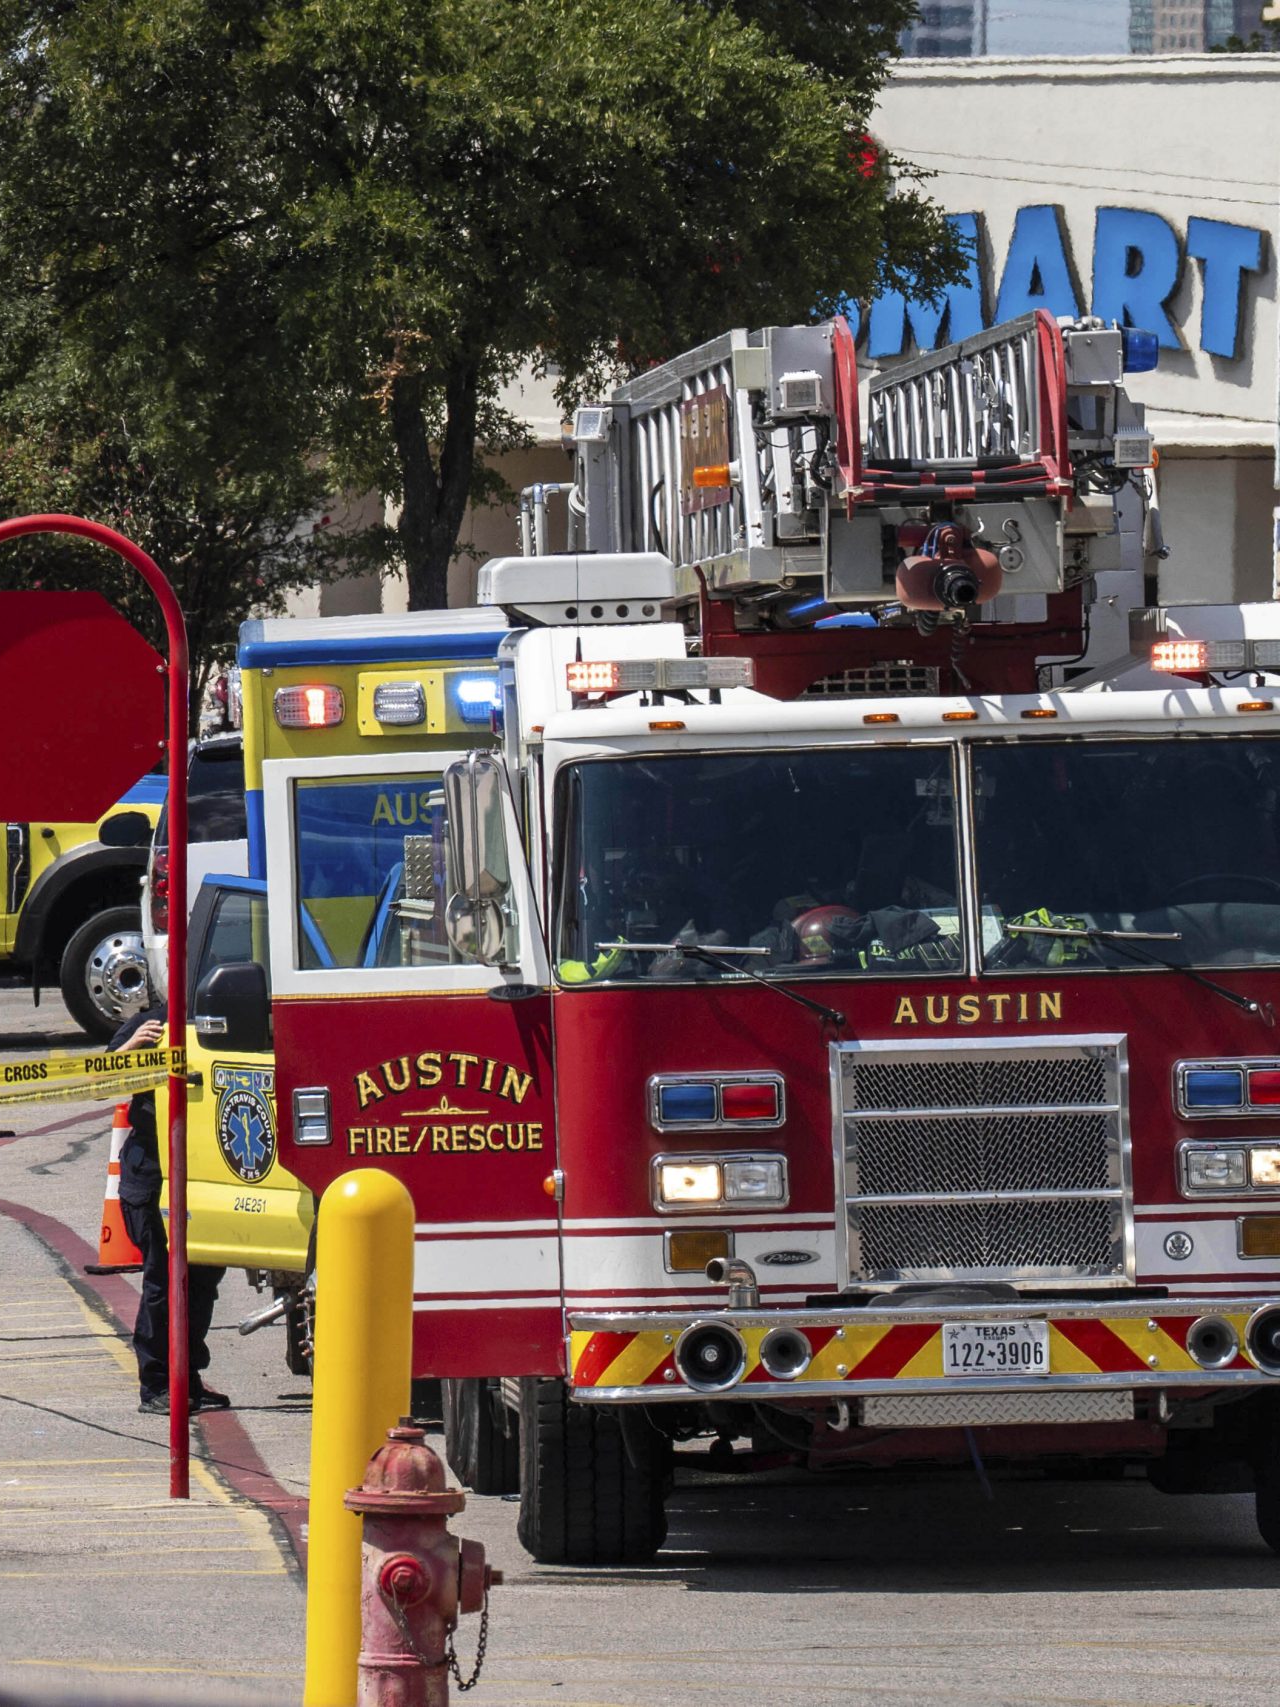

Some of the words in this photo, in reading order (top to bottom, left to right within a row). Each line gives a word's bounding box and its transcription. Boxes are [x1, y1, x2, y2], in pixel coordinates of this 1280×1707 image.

[894, 992, 1063, 1025] AUSTIN
[4, 1063, 48, 1082] CROSS
[84, 1055, 133, 1073] POLICE
[137, 1051, 167, 1067] LINE
[354, 1052, 534, 1110] AUSTIN
[221, 1093, 257, 1152] AUSTIN-TRAVIS
[256, 1103, 273, 1156] COUNTY
[347, 1123, 543, 1155] FIRE/RESCUE
[239, 1168, 261, 1179] EMS
[233, 1197, 267, 1214] 24E251
[974, 1326, 1016, 1337] TEXAS
[949, 1343, 985, 1367] 122
[996, 1341, 1044, 1365] 3906
